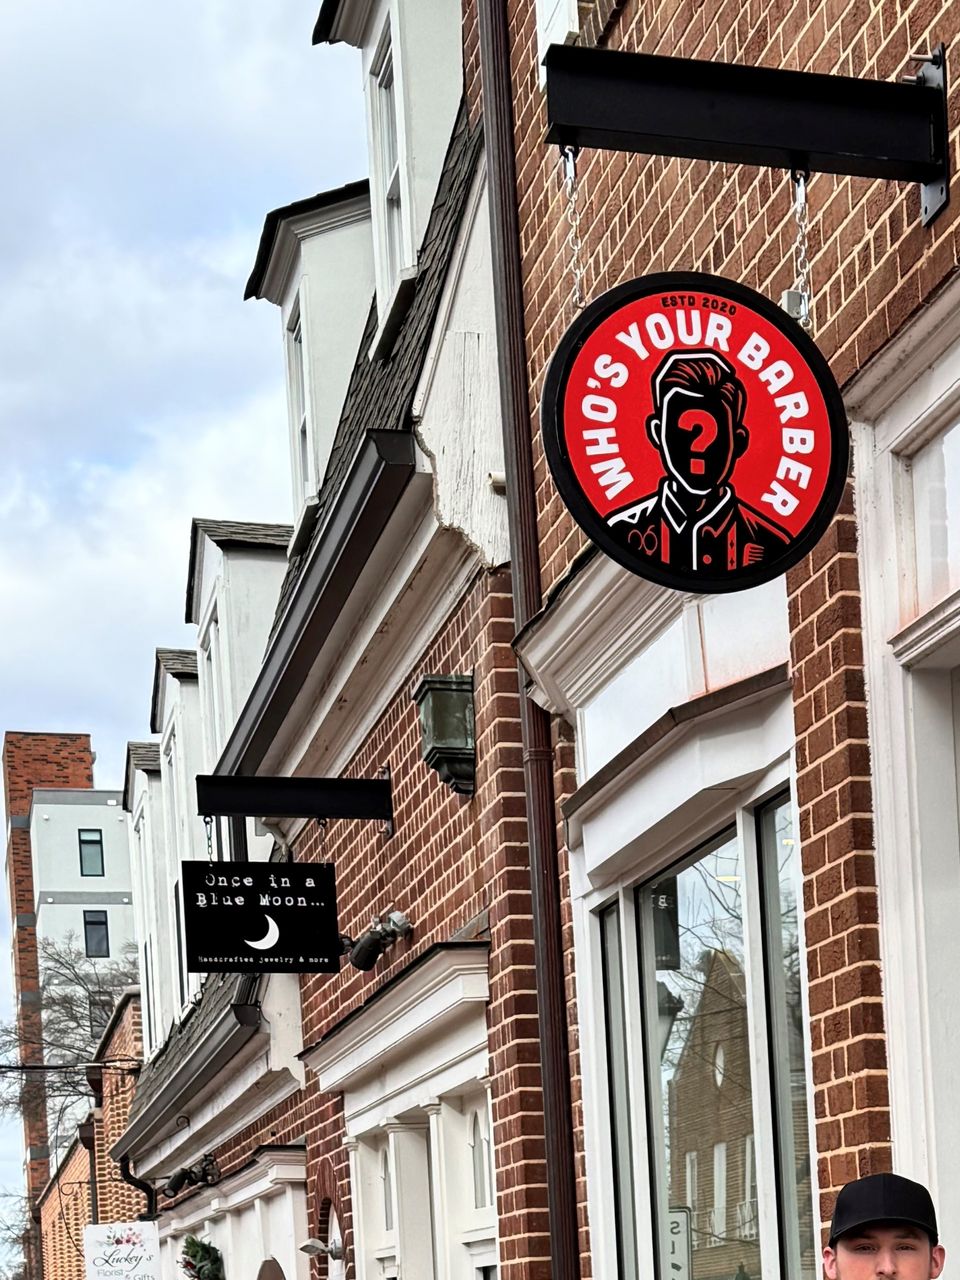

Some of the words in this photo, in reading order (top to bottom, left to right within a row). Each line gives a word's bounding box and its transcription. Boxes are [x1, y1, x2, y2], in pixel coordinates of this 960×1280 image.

[661, 295, 696, 308] ESTD
[702, 297, 737, 316] 2020
[581, 354, 634, 500] WHO'S
[615, 309, 733, 361] YOUR
[736, 332, 815, 517] BARBER
[205, 873, 254, 888] Once
[269, 874, 291, 888] in
[305, 877, 316, 887] a
[196, 892, 245, 907] Blue
[259, 893, 325, 906] Moon...
[97, 1269, 124, 1277] Florist
[133, 1273, 155, 1280] Gifts
